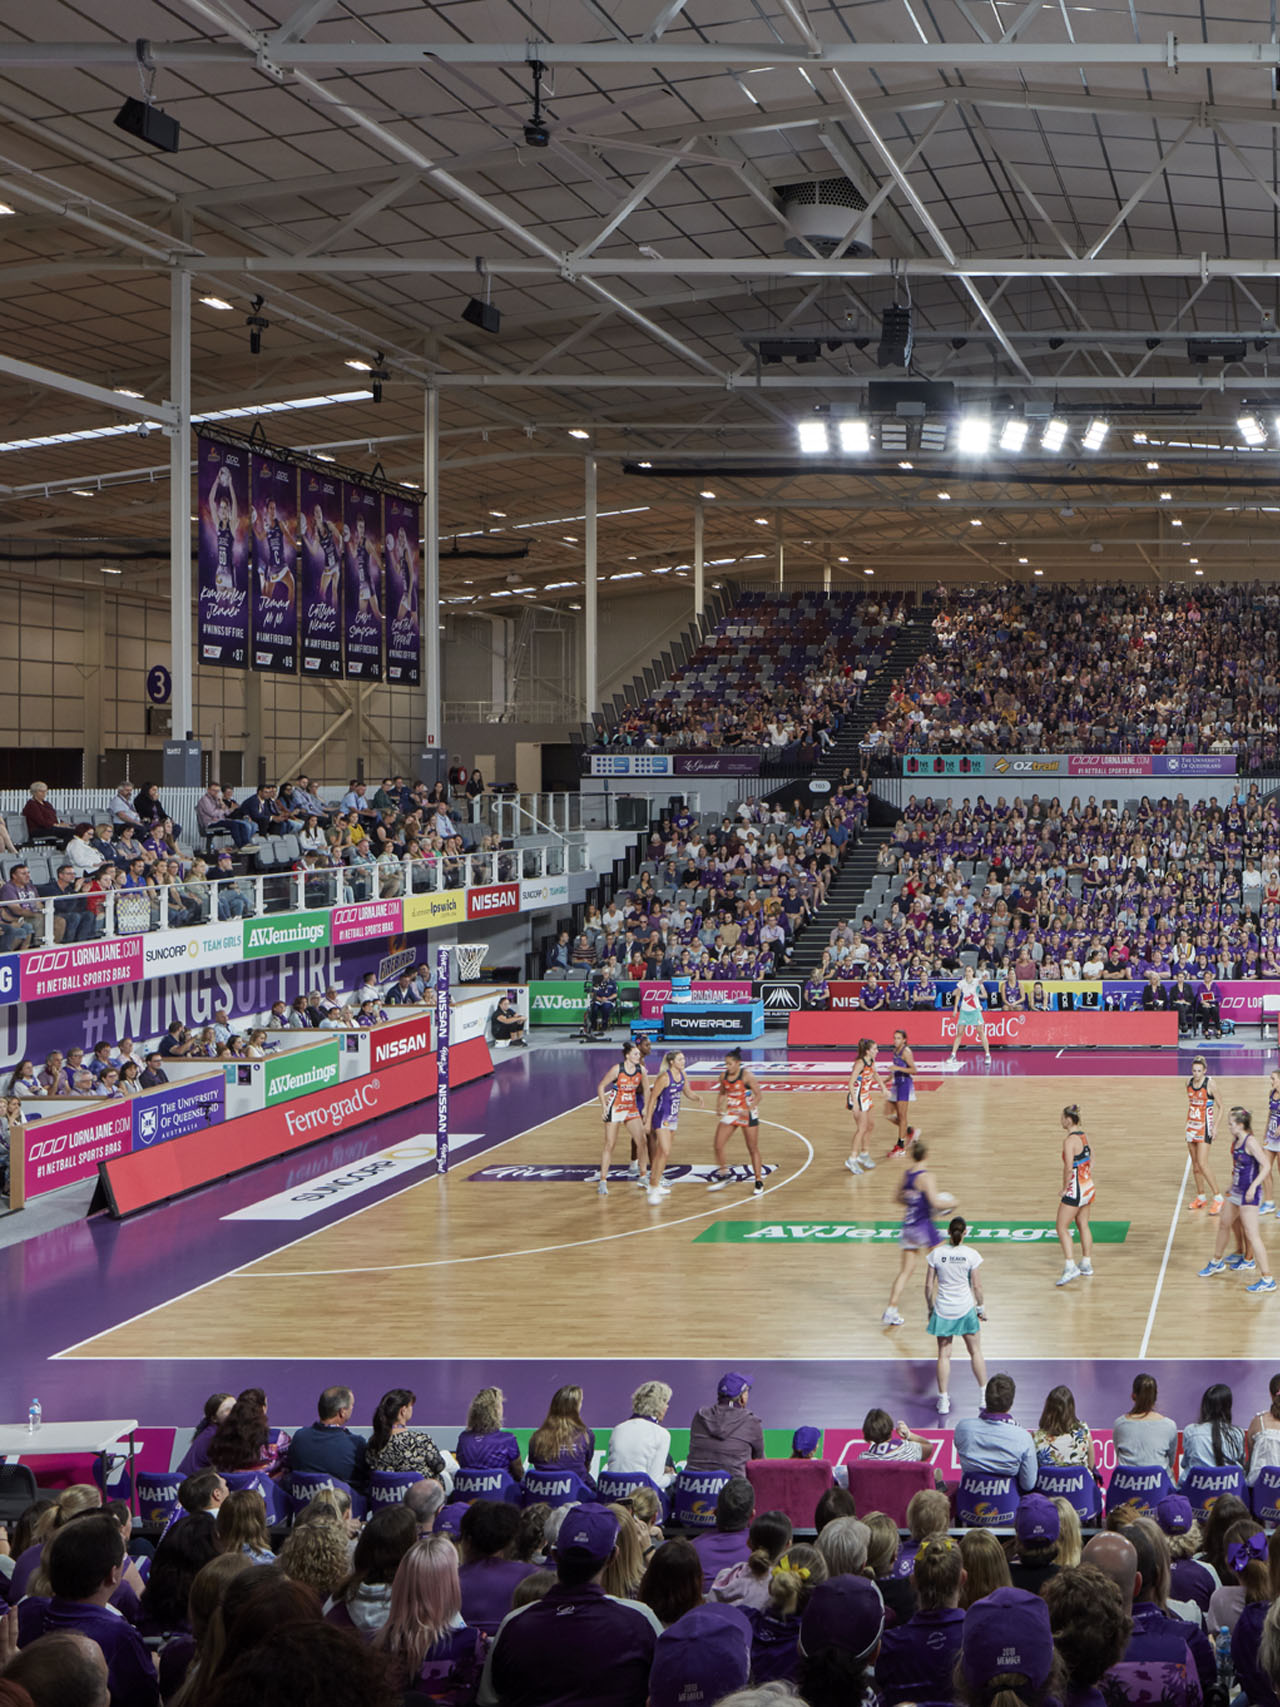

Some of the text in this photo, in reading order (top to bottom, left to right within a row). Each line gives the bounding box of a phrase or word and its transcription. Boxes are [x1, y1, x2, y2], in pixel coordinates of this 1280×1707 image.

[200, 586, 246, 607] Kimberley
[153, 671, 165, 698] 3
[1013, 761, 1060, 771] OZtrail
[1101, 756, 1150, 765] LORNAJANE.COM
[430, 899, 457, 916] Ipswich
[472, 891, 516, 911] NISSAN
[358, 902, 399, 920] LORNAJANE.COM
[248, 923, 325, 947] AVJennings
[364, 923, 381, 937] SPORTS
[72, 940, 140, 967] LORNAJANE.COM
[146, 935, 241, 961] SUNCORP TEAM GIRLS
[378, 948, 416, 983] FIREBIRDS
[0, 966, 12, 993] G
[36, 966, 131, 995] #1 NETBALL SPORTS BRAS
[832, 997, 860, 1008] NIS
[438, 990, 448, 1038] NISSAN
[375, 1032, 427, 1063] NISSAN
[268, 1064, 337, 1097] AVJennings
[161, 1089, 219, 1115] THE UNIVERSITY
[438, 1084, 447, 1133] NISSAN
[69, 1116, 131, 1149] LORNAJANE.COM
[161, 1117, 172, 1129] OF
[161, 1123, 199, 1139] AUSTRALIA
[36, 1140, 122, 1179] #1 NETBALL SPORTS BRAS
[290, 1160, 397, 1202] SUNCORP
[455, 1474, 503, 1492] HAHN
[526, 1478, 572, 1496] HAHN
[600, 1479, 645, 1497] HAHN
[679, 1475, 730, 1494] HAHN
[964, 1478, 1011, 1495] HAHN
[1036, 1475, 1084, 1493] HAHN
[1114, 1472, 1162, 1491] HAHN
[1191, 1472, 1239, 1490] HAHN
[960, 1510, 1014, 1523] FIREBIRDS
